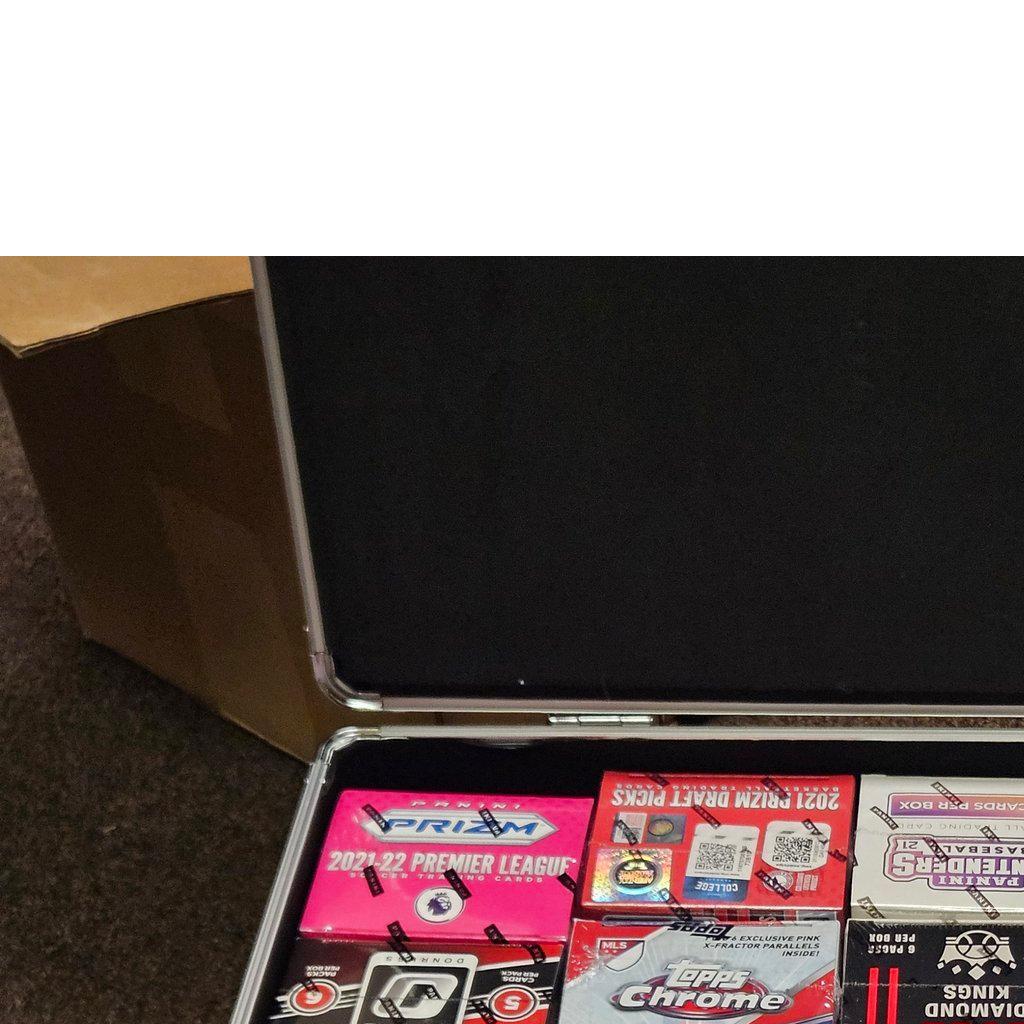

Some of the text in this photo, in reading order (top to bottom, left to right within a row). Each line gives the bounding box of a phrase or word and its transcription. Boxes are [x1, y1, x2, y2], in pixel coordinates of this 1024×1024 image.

[611, 788, 840, 811] 2021 DRAFT PICKS
[900, 801, 932, 809] BOX
[385, 818, 539, 836] PRIZM
[902, 841, 918, 849] 21
[327, 852, 570, 876] 2021-22 PREMIER LEAGUE
[694, 881, 739, 893] COLLEGE
[938, 876, 1020, 886] PANINI
[895, 934, 915, 942] PER
[601, 941, 627, 949] MLS
[619, 987, 786, 1010] Chrome
[944, 985, 1009, 999] KINGS
[504, 996, 520, 1010] 5
